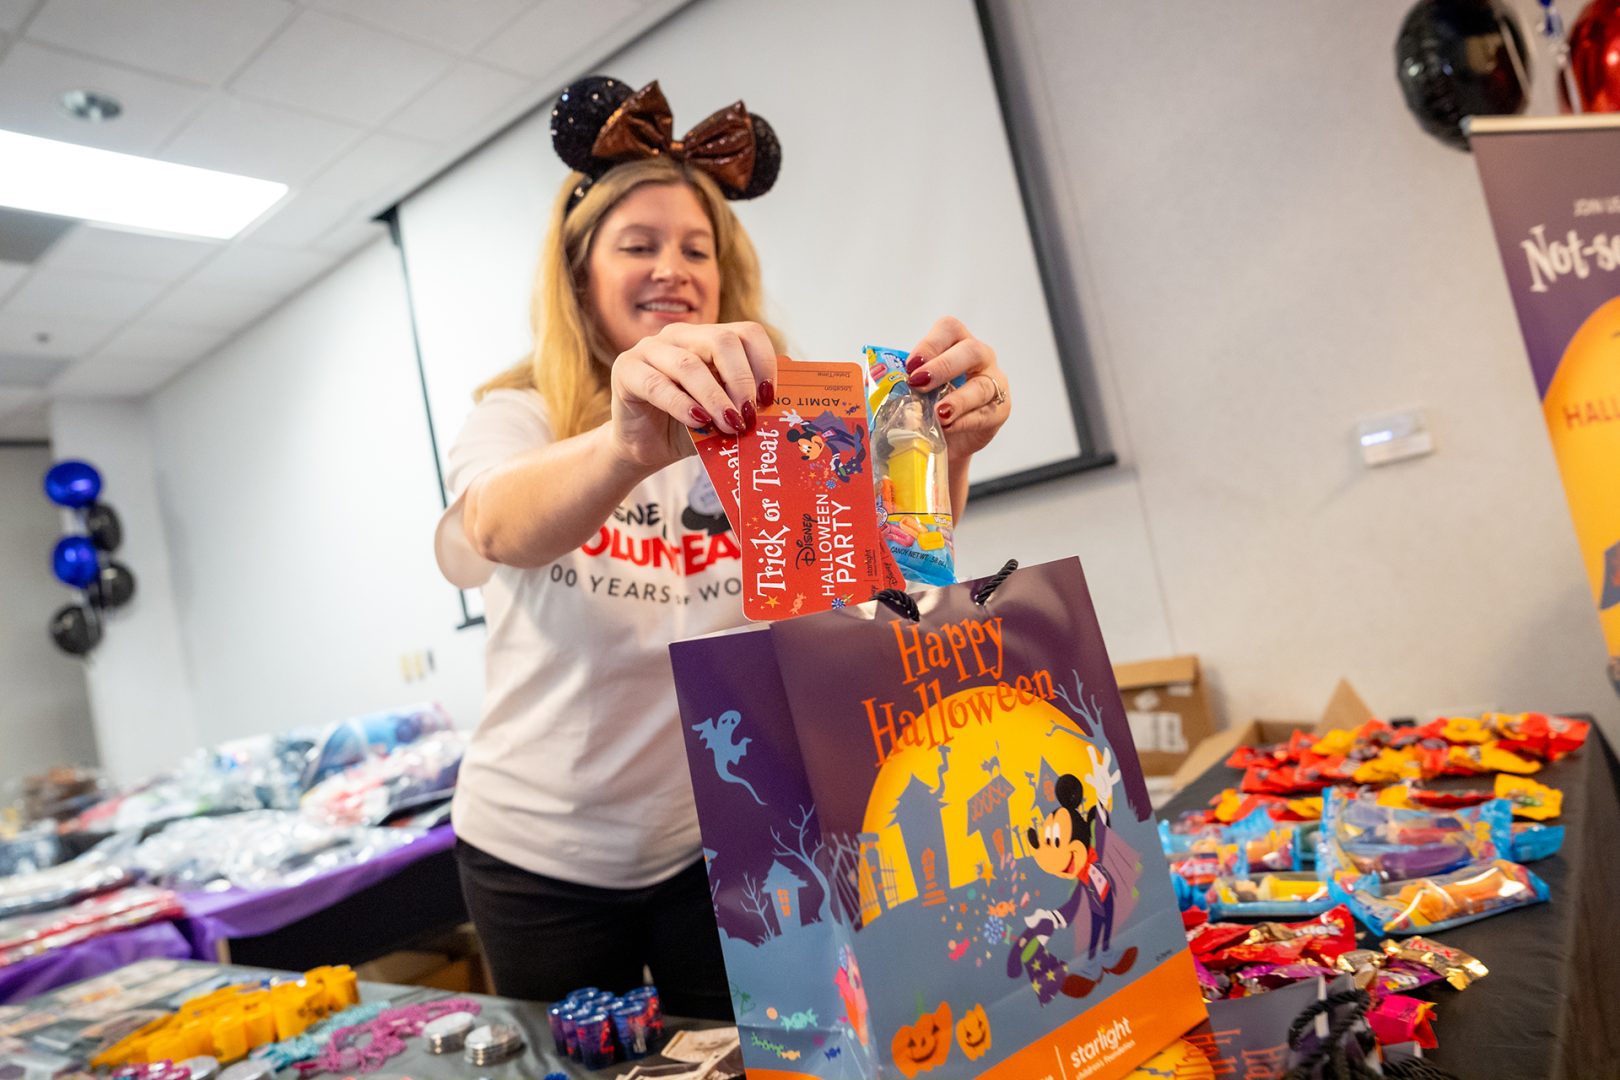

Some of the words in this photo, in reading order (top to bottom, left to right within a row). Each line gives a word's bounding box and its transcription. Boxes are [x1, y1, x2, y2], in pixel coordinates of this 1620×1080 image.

[771, 396, 791, 407] ON
[796, 397, 840, 407] ADMIT
[1562, 396, 1620, 430] HALL
[752, 428, 781, 492] Treat
[762, 498, 781, 522] or
[750, 524, 792, 597] Trick
[815, 494, 836, 596] HALLOWEEN
[831, 500, 857, 583] PARTY
[551, 563, 577, 588] 00
[590, 575, 670, 604] YEARS
[698, 577, 742, 602] WO
[888, 617, 1005, 684] Happy
[861, 668, 1058, 768] Halloween
[1070, 1016, 1132, 1069] starlight
